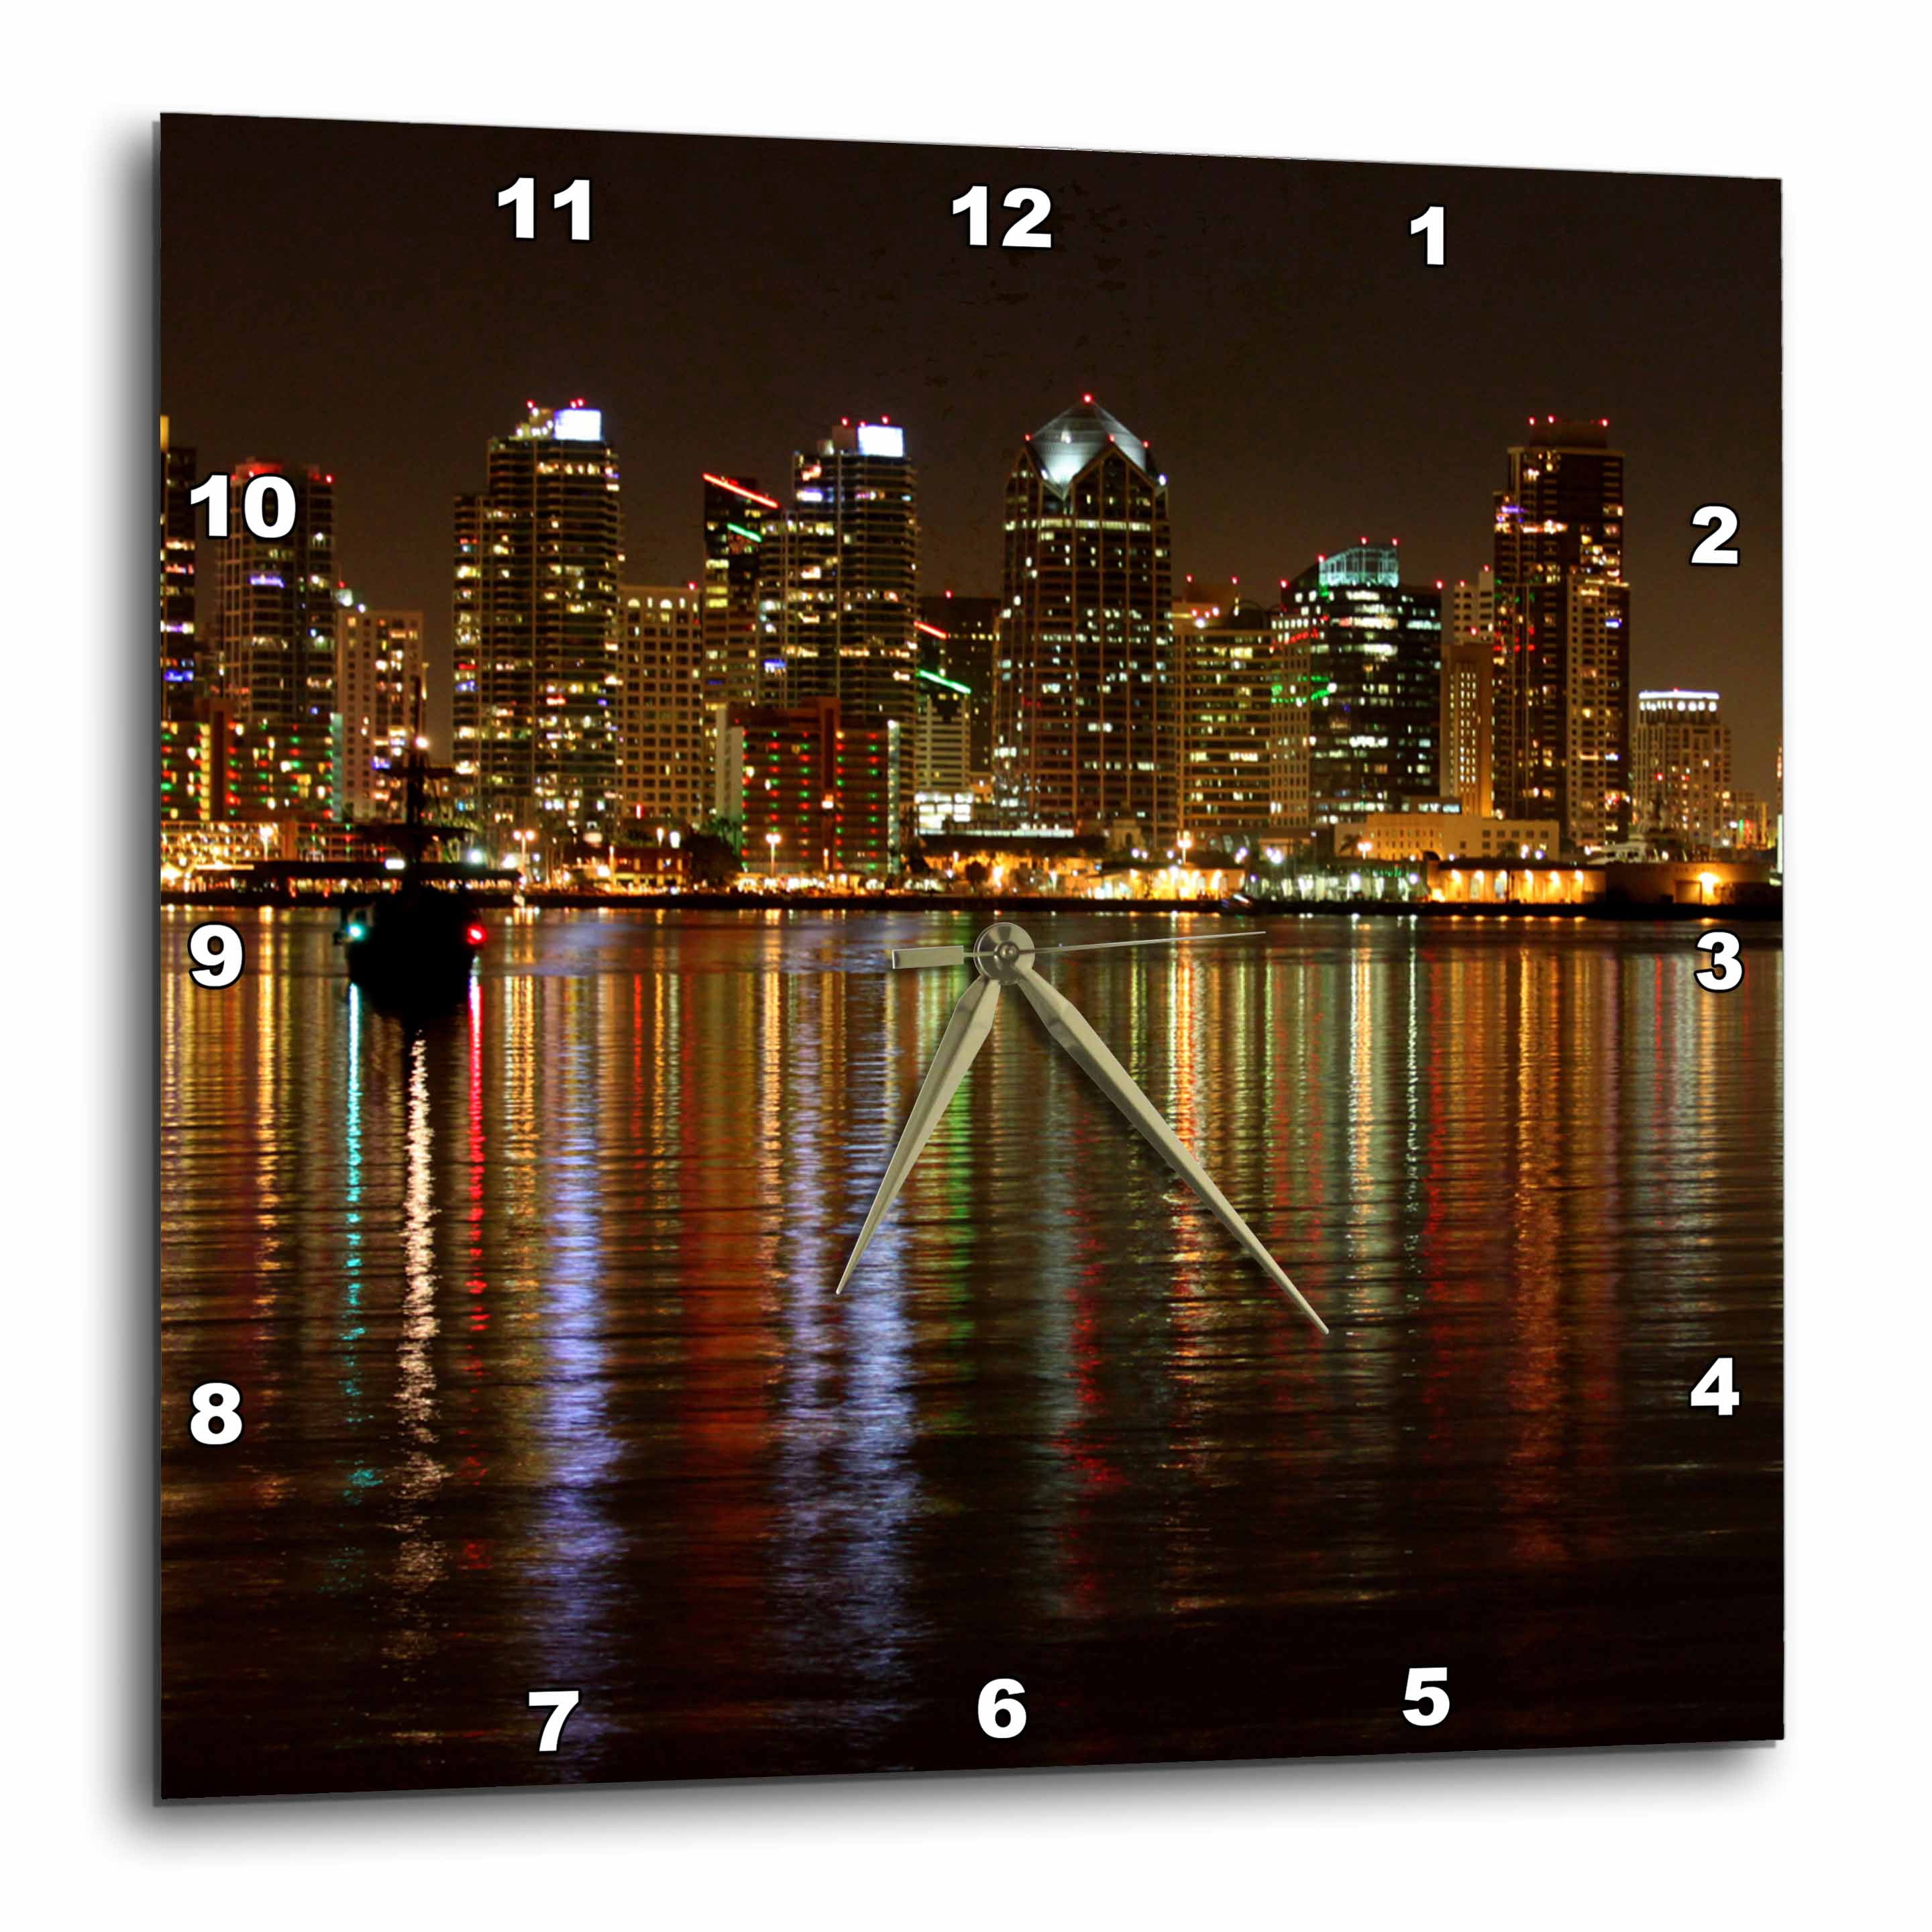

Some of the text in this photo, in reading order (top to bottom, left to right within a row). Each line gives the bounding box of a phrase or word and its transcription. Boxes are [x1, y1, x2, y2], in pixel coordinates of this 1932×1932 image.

[498, 176, 590, 241] 11
[952, 185, 1052, 248] 12
[1410, 205, 1445, 266] 1
[190, 474, 297, 539] 10
[1690, 505, 1739, 565] 2
[190, 924, 243, 987] 9
[1696, 931, 1743, 991] 3
[190, 1382, 243, 1446] 8
[1690, 1356, 1740, 1416] 4
[528, 1690, 580, 1752] 7
[977, 1678, 1027, 1739] 6
[1402, 1666, 1450, 1727] 5
